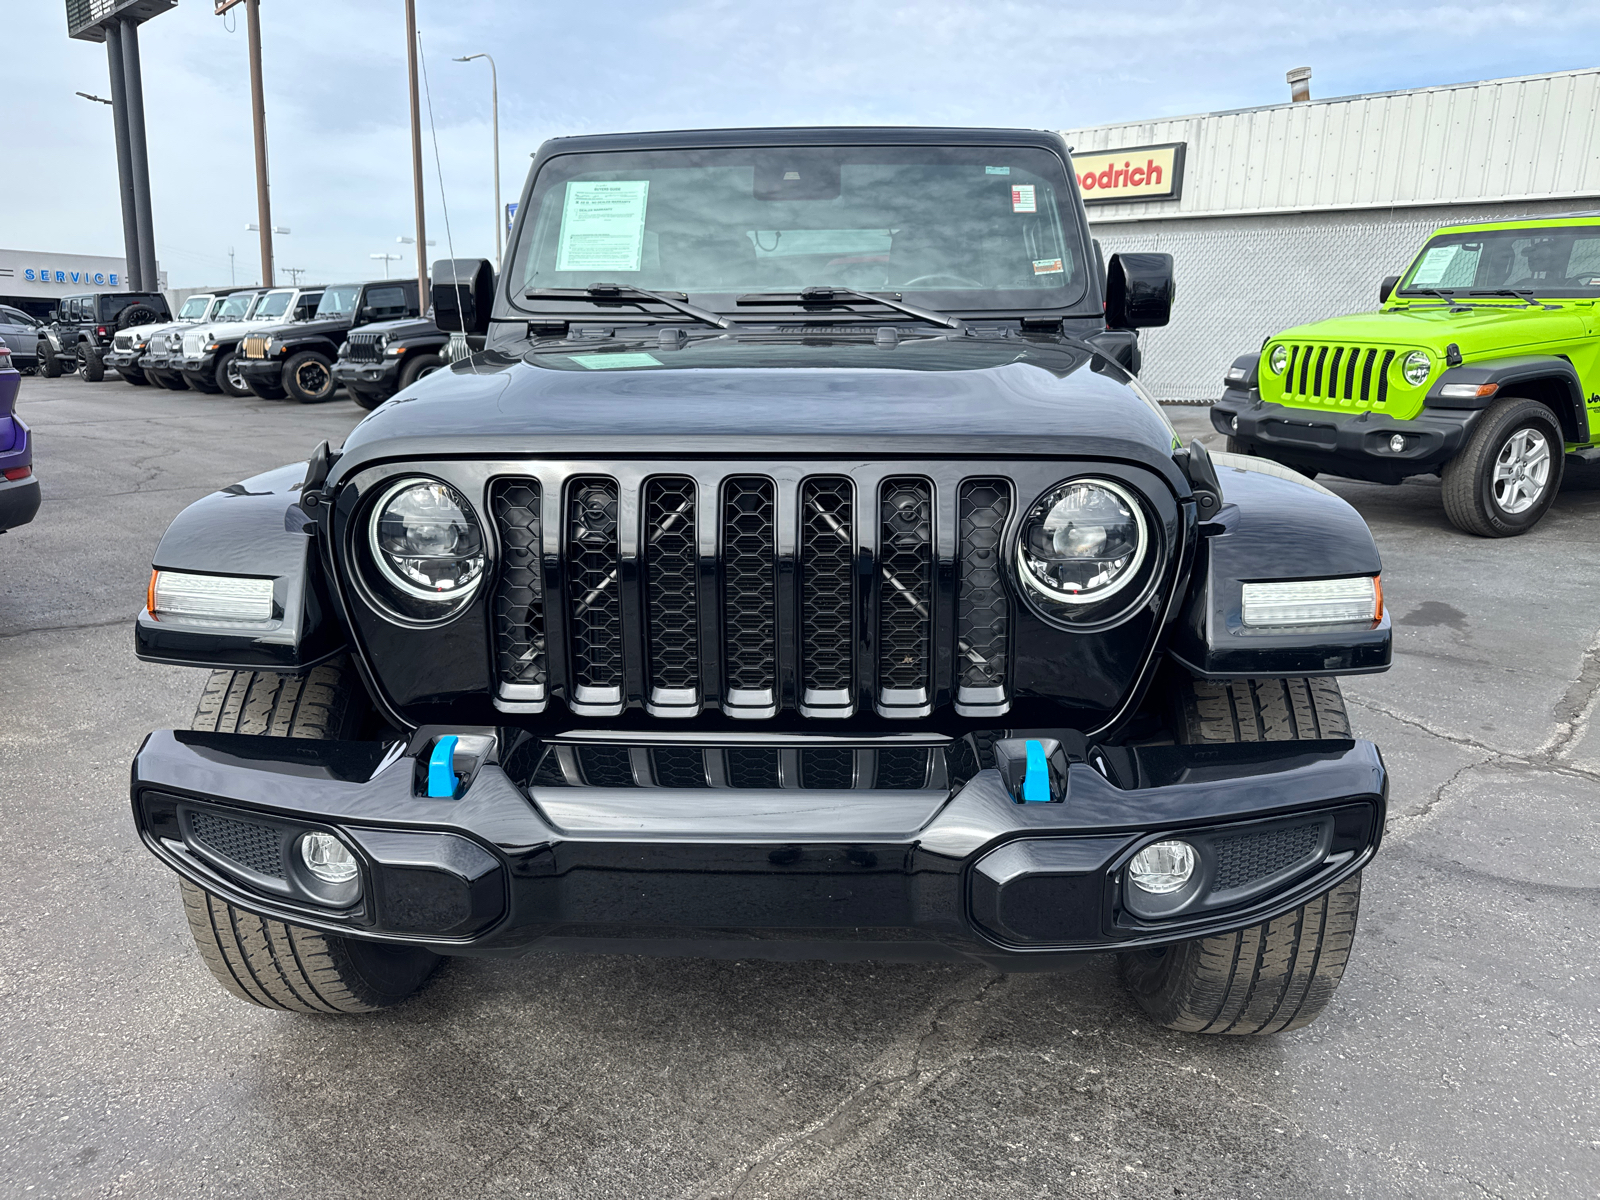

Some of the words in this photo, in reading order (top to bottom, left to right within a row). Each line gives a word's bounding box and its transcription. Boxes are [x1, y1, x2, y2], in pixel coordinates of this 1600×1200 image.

[1075, 158, 1163, 191] odrich
[24, 268, 119, 286] SERVICE
[1587, 392, 1600, 404] Je
